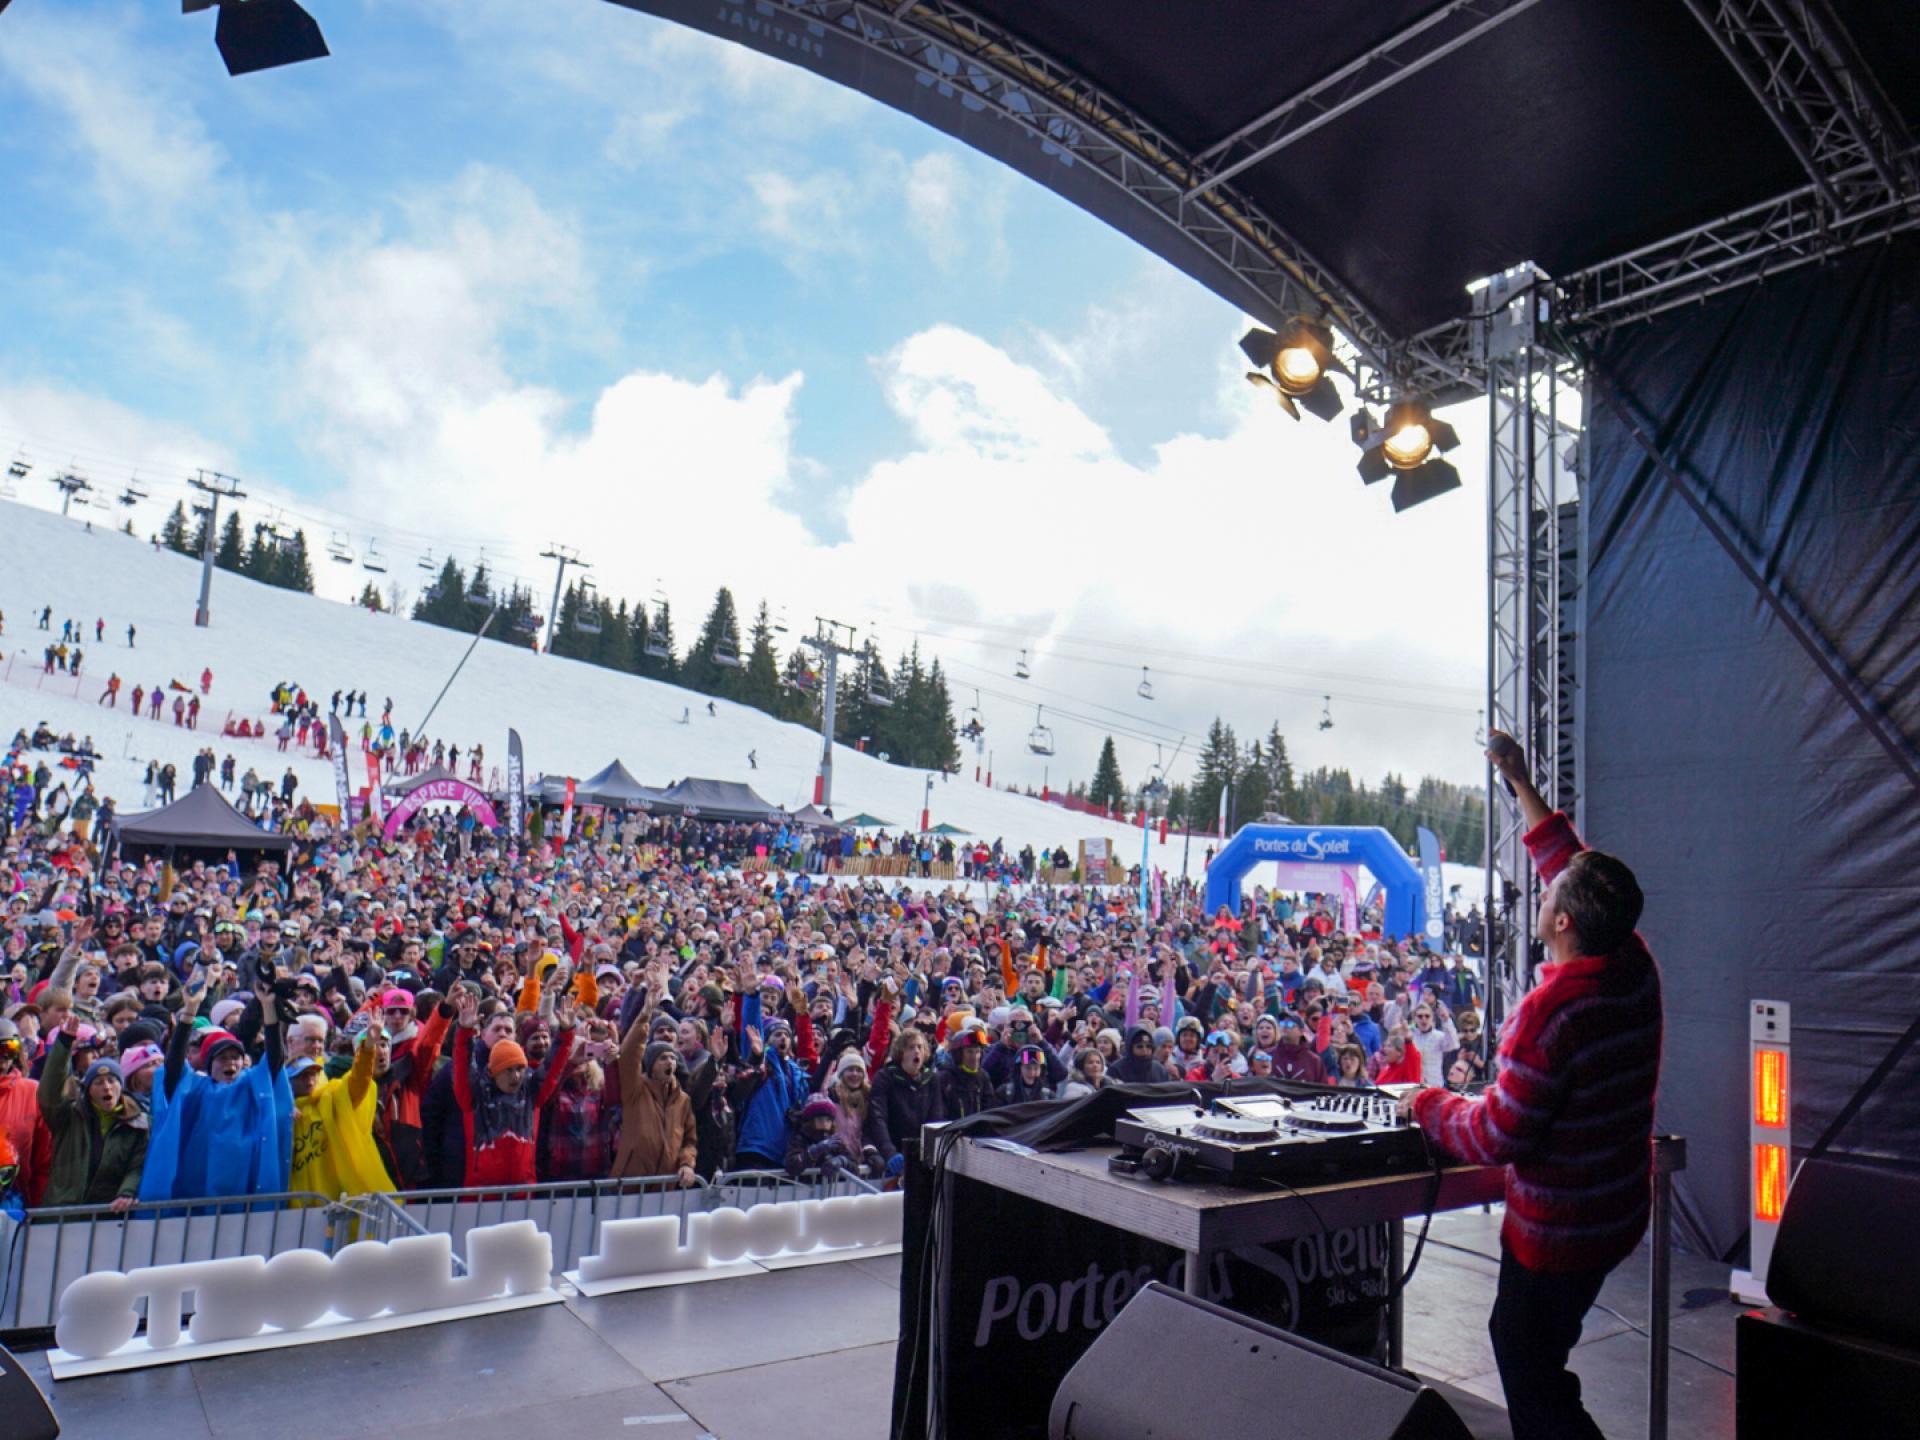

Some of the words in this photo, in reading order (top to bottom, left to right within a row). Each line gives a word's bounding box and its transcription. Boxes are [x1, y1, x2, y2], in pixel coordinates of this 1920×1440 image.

[402, 782, 456, 812] ESPACE
[462, 786, 484, 806] VIP
[1255, 838, 1290, 853] Portes
[1291, 839, 1307, 853] du
[1304, 831, 1350, 861] Soleil
[1143, 1131, 1201, 1156] Pioneer
